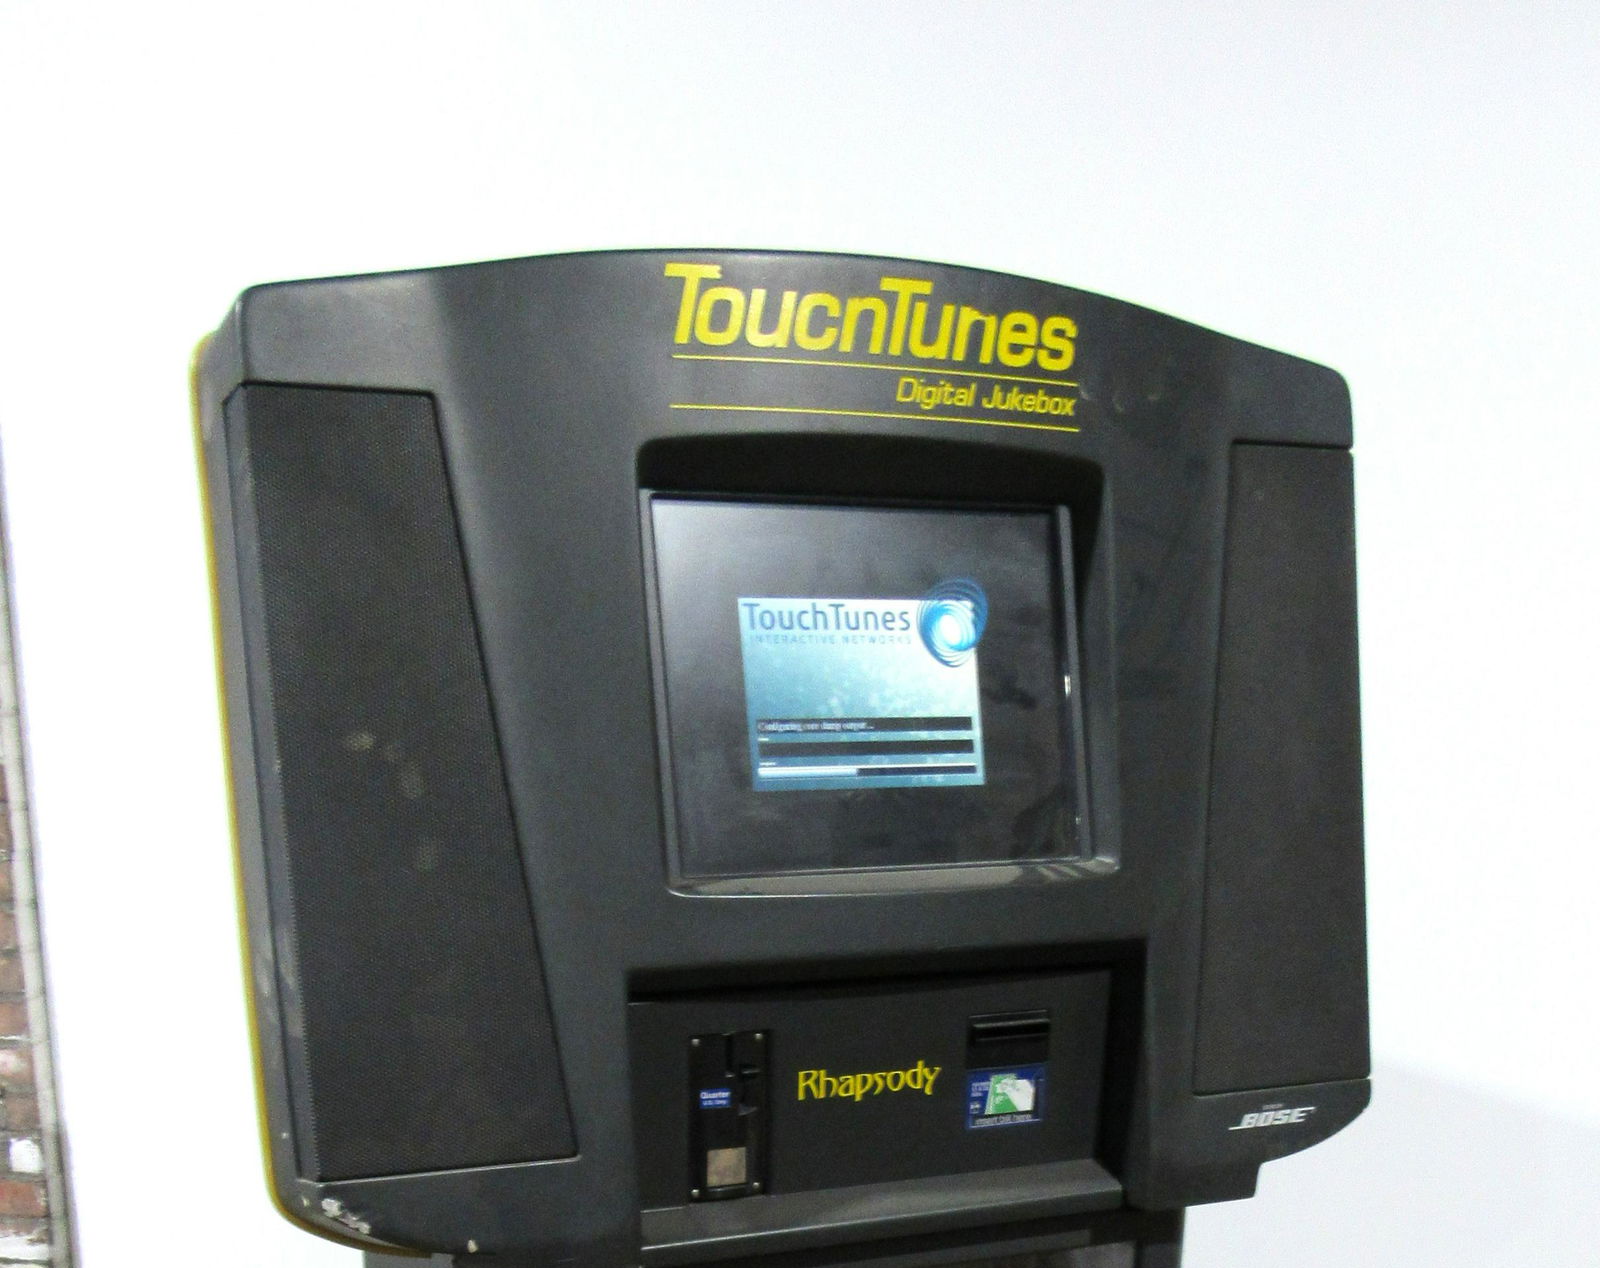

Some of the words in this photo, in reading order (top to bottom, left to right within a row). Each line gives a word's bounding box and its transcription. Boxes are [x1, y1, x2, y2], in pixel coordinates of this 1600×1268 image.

[896, 376, 976, 410] Digital
[981, 384, 1076, 417] Jukebox
[741, 602, 911, 632] TouchTunes
[751, 634, 837, 645] INTERACTIVE
[841, 634, 912, 645] NETWORKS
[798, 1060, 941, 1101] Rhapsody
[1228, 1107, 1317, 1130] BOSE
